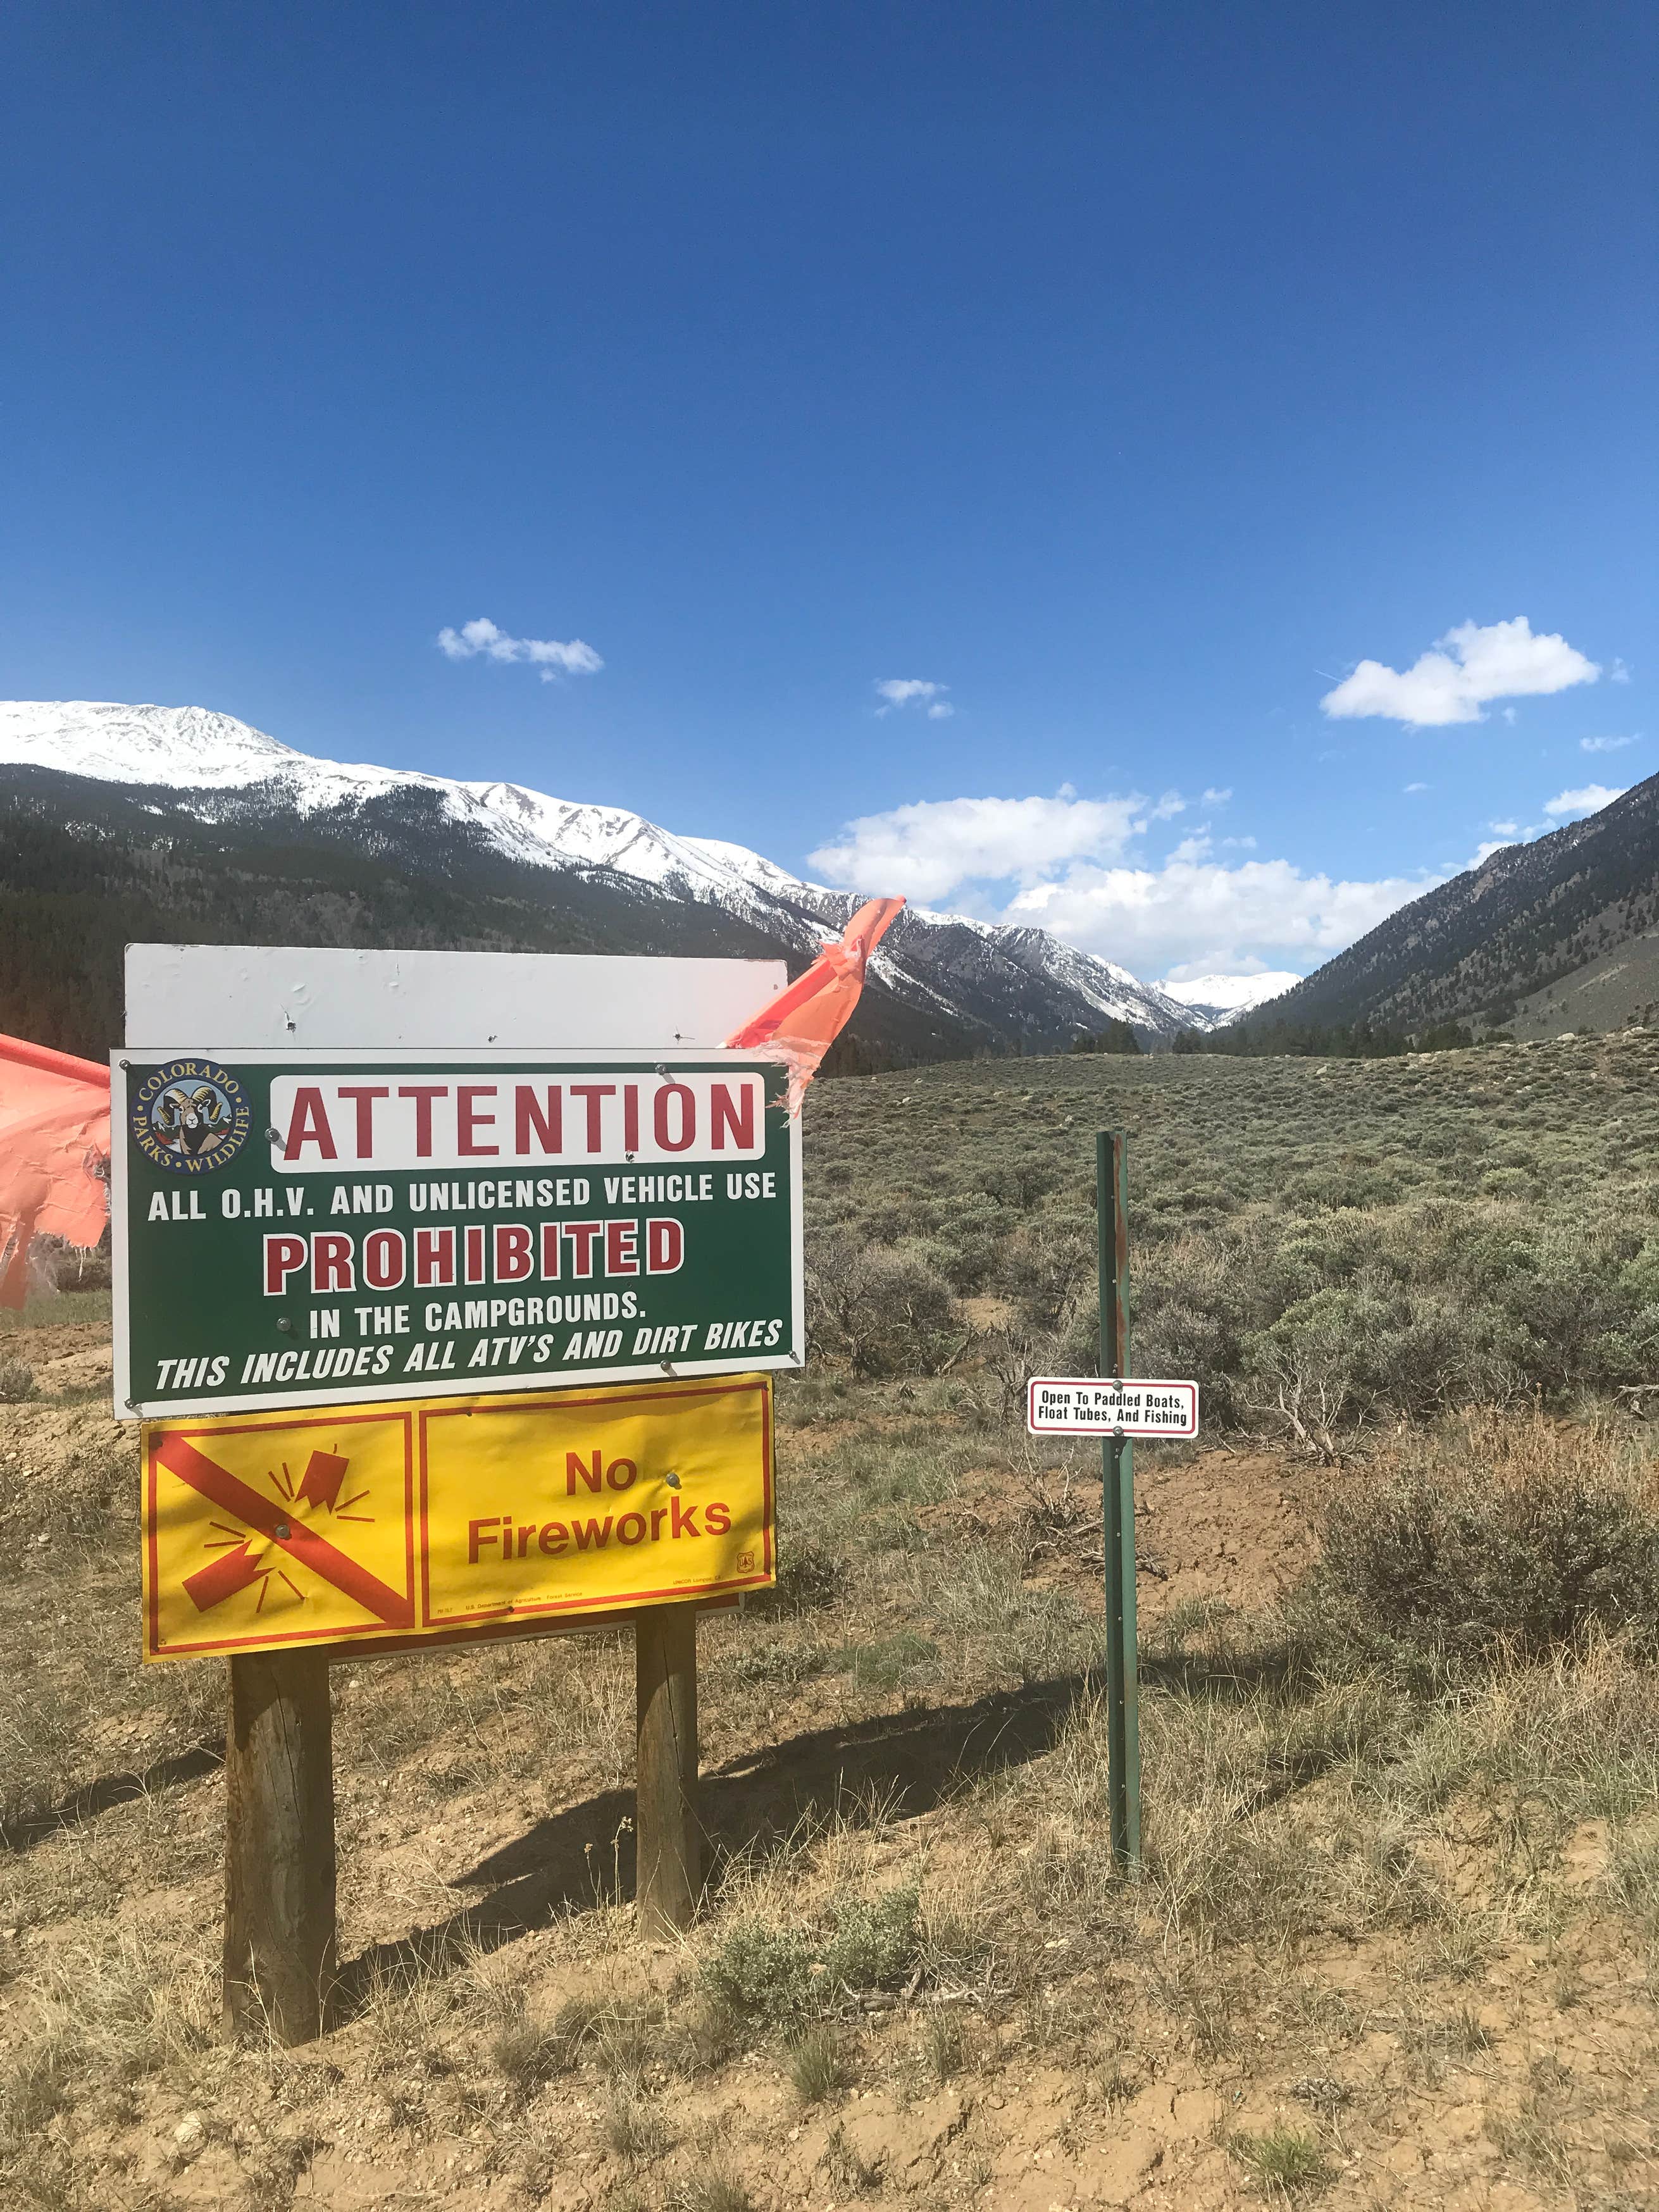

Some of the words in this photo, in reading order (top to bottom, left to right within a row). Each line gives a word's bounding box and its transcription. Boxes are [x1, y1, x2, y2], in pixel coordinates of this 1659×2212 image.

[139, 1062, 239, 1101] COLORADO
[133, 1115, 173, 1166] PARKS
[185, 1106, 249, 1172] WILDLIFE
[283, 1084, 754, 1160] ATTENTION
[147, 1190, 206, 1221] ALL
[221, 1186, 314, 1218] O.H.V.
[330, 1183, 394, 1215] AND
[409, 1177, 590, 1212] UNLICENSED
[604, 1174, 714, 1203] VEHICLE
[726, 1172, 777, 1200] USE
[263, 1217, 685, 1296] PROHIBITED
[309, 1309, 340, 1339] IN
[354, 1304, 410, 1336] THE
[425, 1291, 646, 1332] CAMPGROUNDS.
[155, 1355, 230, 1390] THIS
[240, 1345, 394, 1384] INCLUDES
[402, 1340, 456, 1372] ALL
[467, 1333, 554, 1368] ATV'S
[562, 1329, 623, 1361] AND
[631, 1324, 698, 1356] DIRT
[704, 1319, 783, 1351] BIKES
[1038, 1406, 1068, 1420] Float
[1074, 1407, 1111, 1422] Tubes,
[1117, 1408, 1139, 1422] And
[1145, 1410, 1187, 1426] Fishing
[1041, 1390, 1071, 1405] Open
[1076, 1391, 1089, 1405] To
[1095, 1392, 1140, 1407] Paddled
[1146, 1394, 1184, 1409] Boats,
[566, 1450, 638, 1496] No
[468, 1496, 731, 1564] Fireworks
[478, 1600, 506, 1610] Department
[515, 1596, 542, 1605] Agriculture
